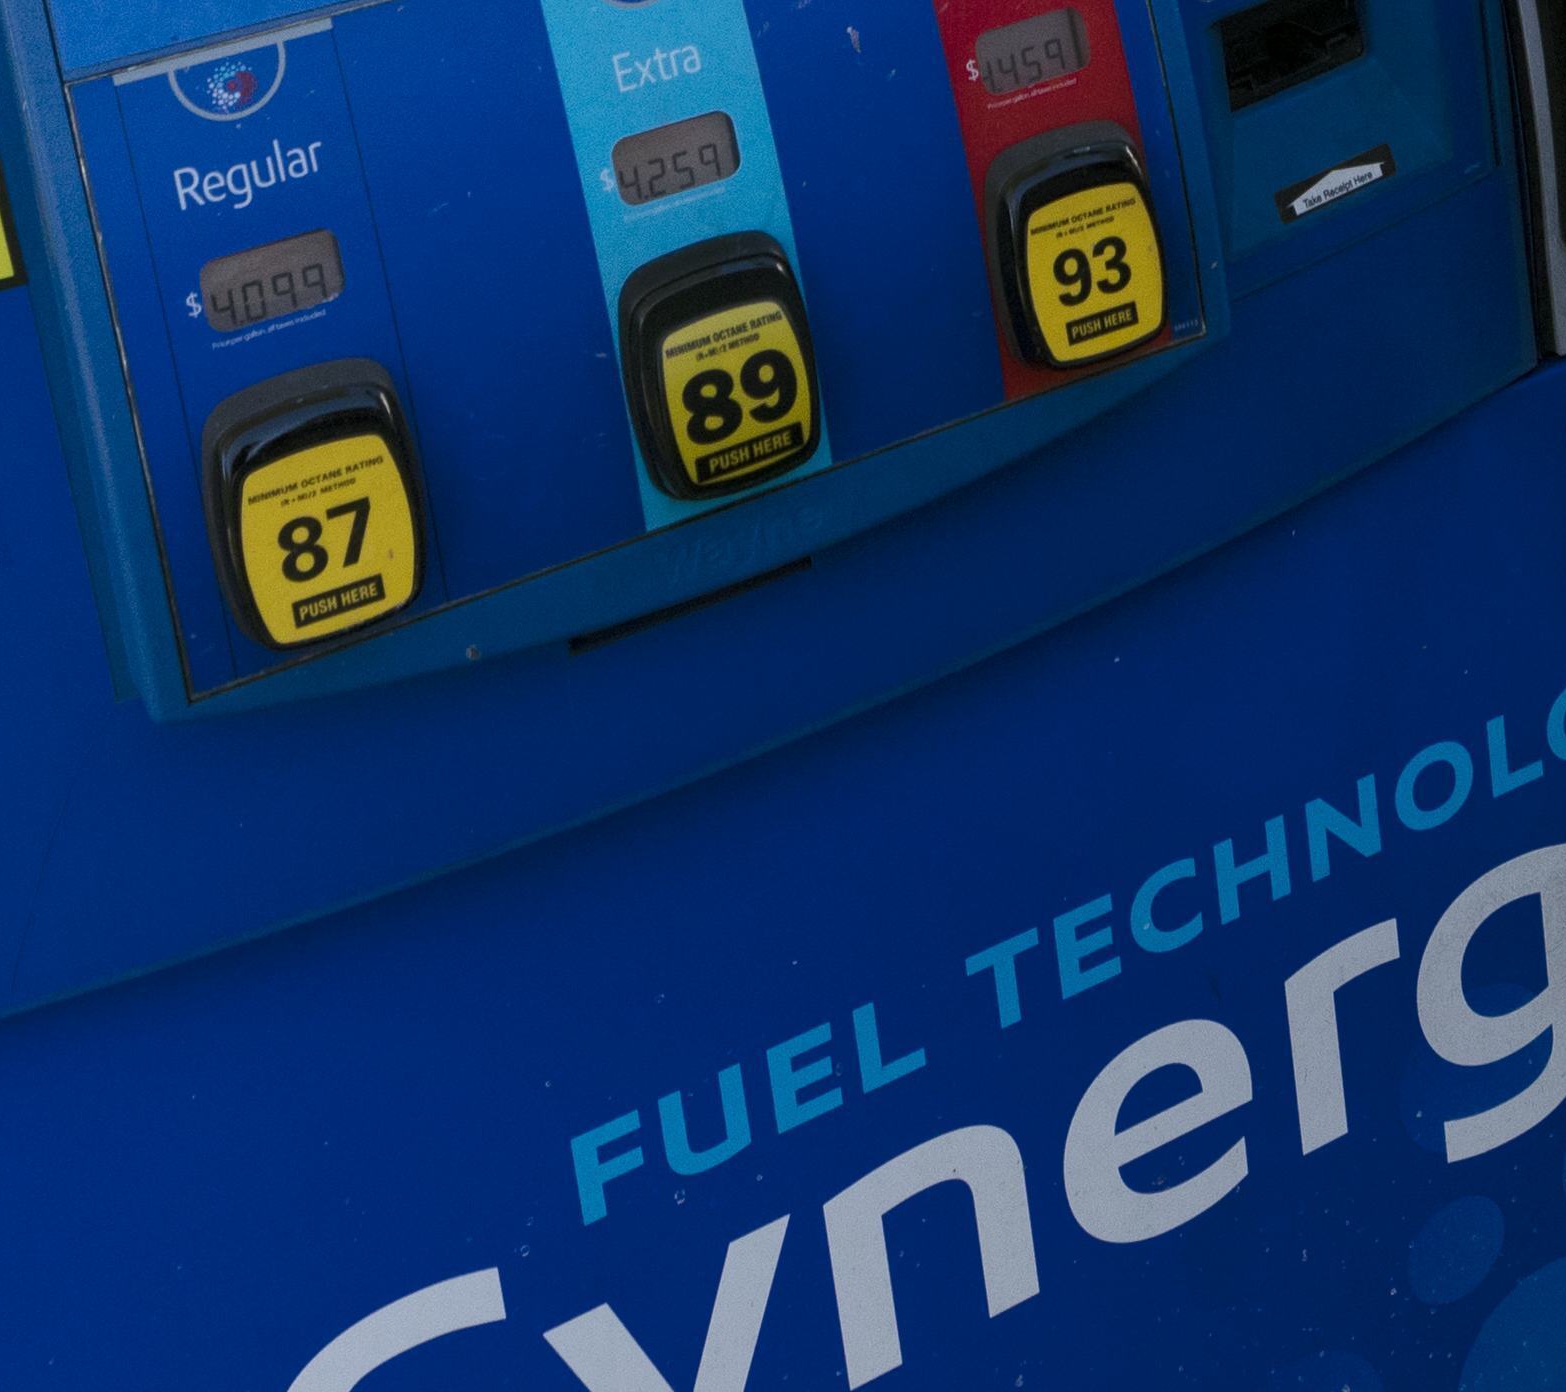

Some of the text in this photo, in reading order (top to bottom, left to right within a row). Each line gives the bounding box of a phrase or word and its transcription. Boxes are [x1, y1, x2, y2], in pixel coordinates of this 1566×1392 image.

[611, 40, 703, 94] Extra
[173, 138, 324, 210] Regular
[618, 143, 721, 200] 4.259
[1302, 170, 1373, 210] Take Receipt Here
[211, 263, 328, 325] 4.099
[1053, 236, 1132, 306] 93
[1071, 309, 1132, 339] PUSH HERE
[682, 349, 797, 445] 89
[248, 482, 298, 505] MINIMUM
[301, 469, 343, 488] OCTANE
[346, 456, 383, 474] RATING
[709, 431, 792, 474] PUSH HERE
[277, 496, 370, 583] 87
[299, 583, 378, 620] PUSH HERE
[570, 1003, 929, 1228] FUEL
